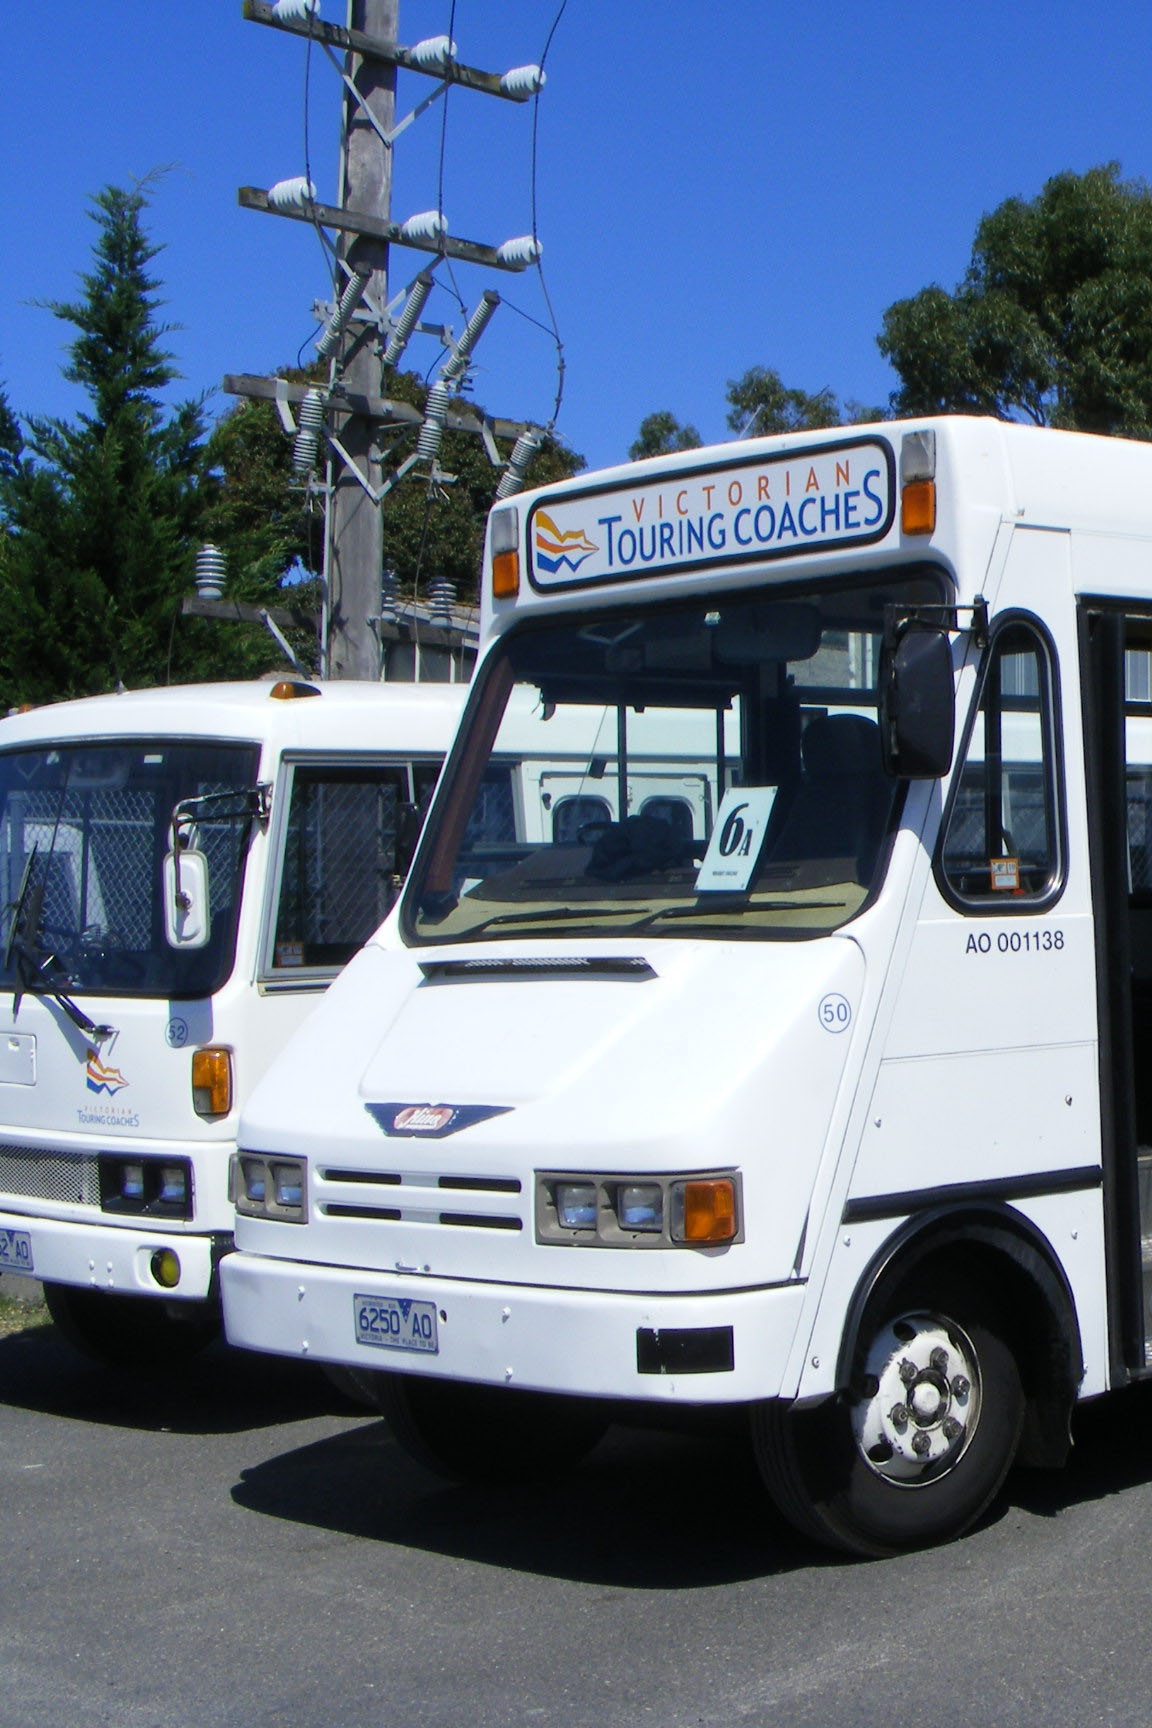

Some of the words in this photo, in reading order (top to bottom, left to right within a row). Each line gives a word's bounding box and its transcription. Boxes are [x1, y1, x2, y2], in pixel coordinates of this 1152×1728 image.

[632, 459, 850, 523] VICTORIAN
[598, 512, 726, 567] TOURING
[734, 469, 883, 546] COACHES
[719, 802, 753, 857] 6A
[965, 932, 991, 954] AO
[997, 930, 1065, 953] 001138
[823, 1003, 848, 1023] 50
[168, 1024, 185, 1042] 52
[77, 1109, 105, 1125] TOURING
[107, 1114, 140, 1127] COACHES
[359, 1307, 400, 1335] 6250
[412, 1313, 432, 1339] AO
